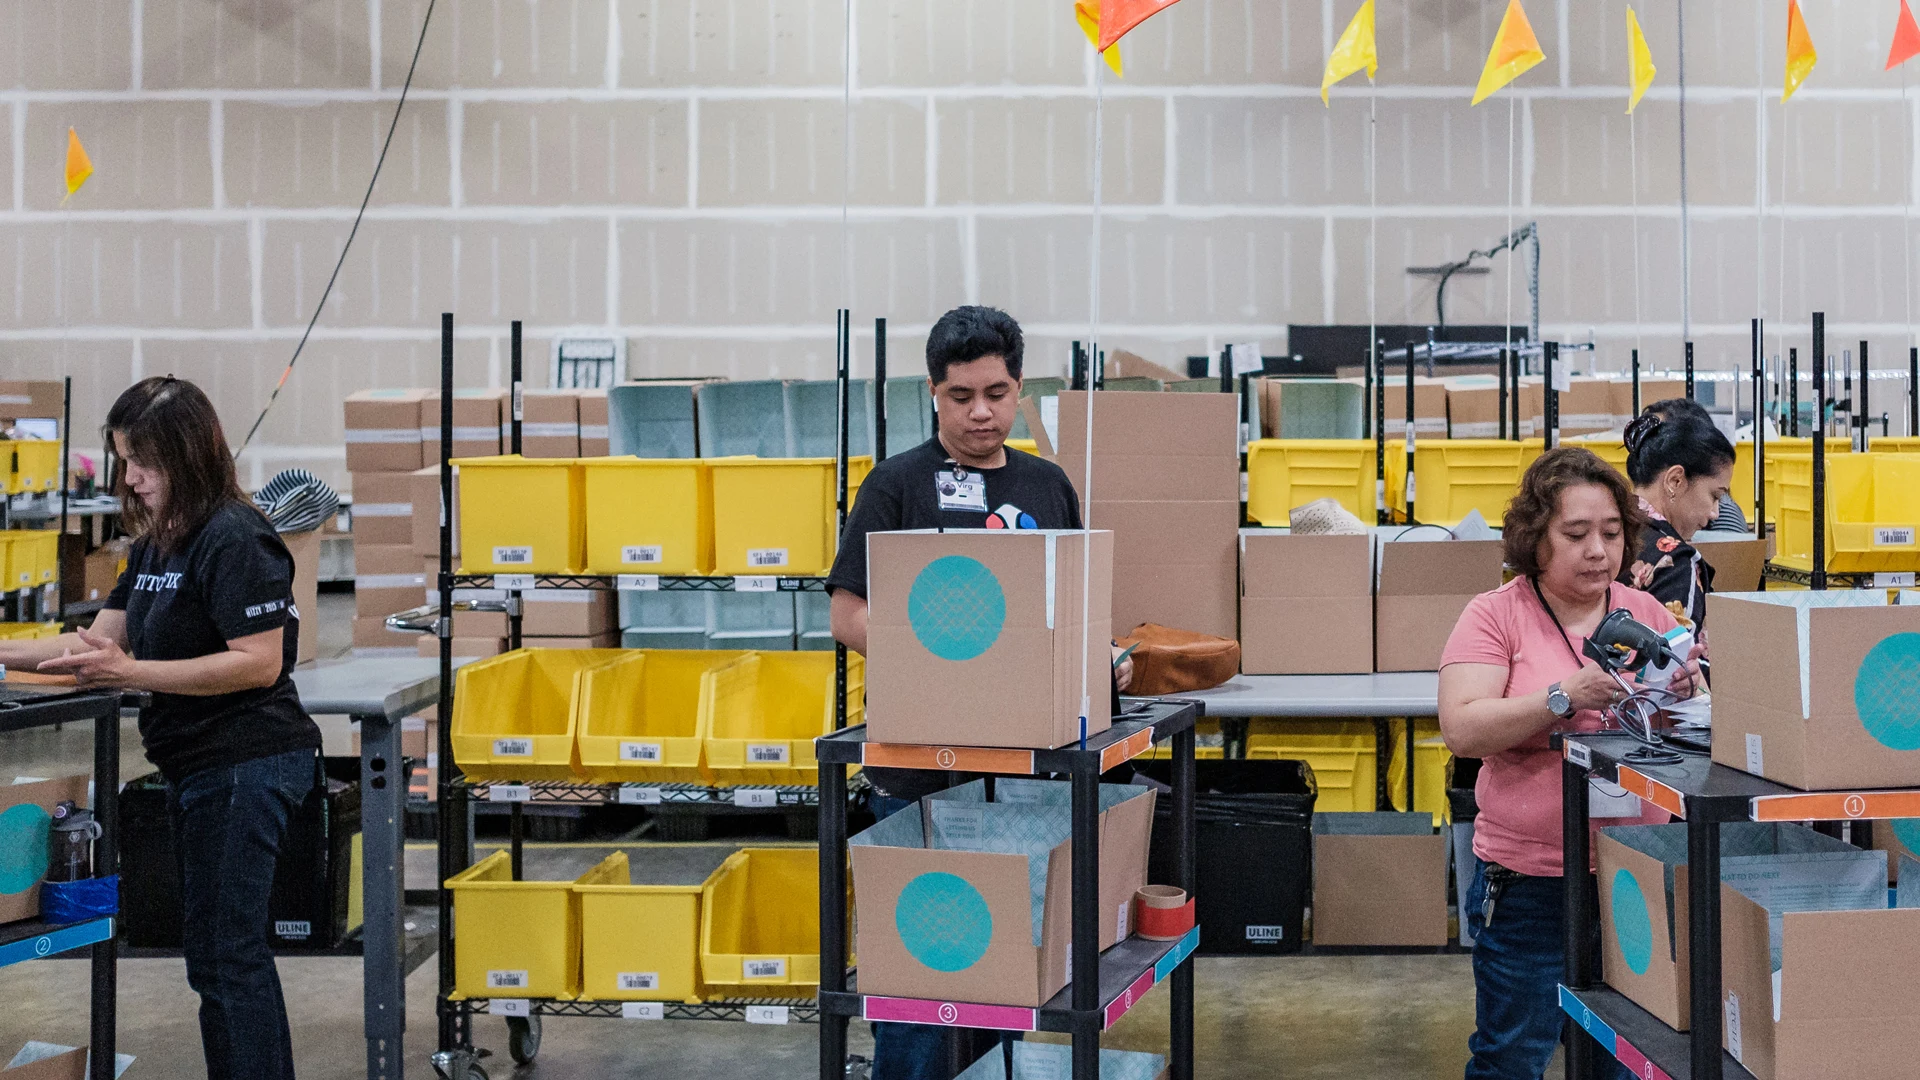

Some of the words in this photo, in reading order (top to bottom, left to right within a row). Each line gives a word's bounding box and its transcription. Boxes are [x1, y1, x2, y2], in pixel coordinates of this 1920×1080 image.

[510, 578, 523, 587] A3
[634, 579, 647, 587] A2
[751, 579, 764, 588] A1
[1890, 576, 1902, 584] A1
[505, 789, 518, 798] B3
[635, 792, 648, 801] B2
[751, 794, 763, 803] B1
[277, 923, 309, 934] ULINE
[1248, 927, 1281, 938] ULINE
[505, 1002, 517, 1011] C3
[638, 1006, 650, 1015] C2
[762, 1009, 774, 1019] C1
